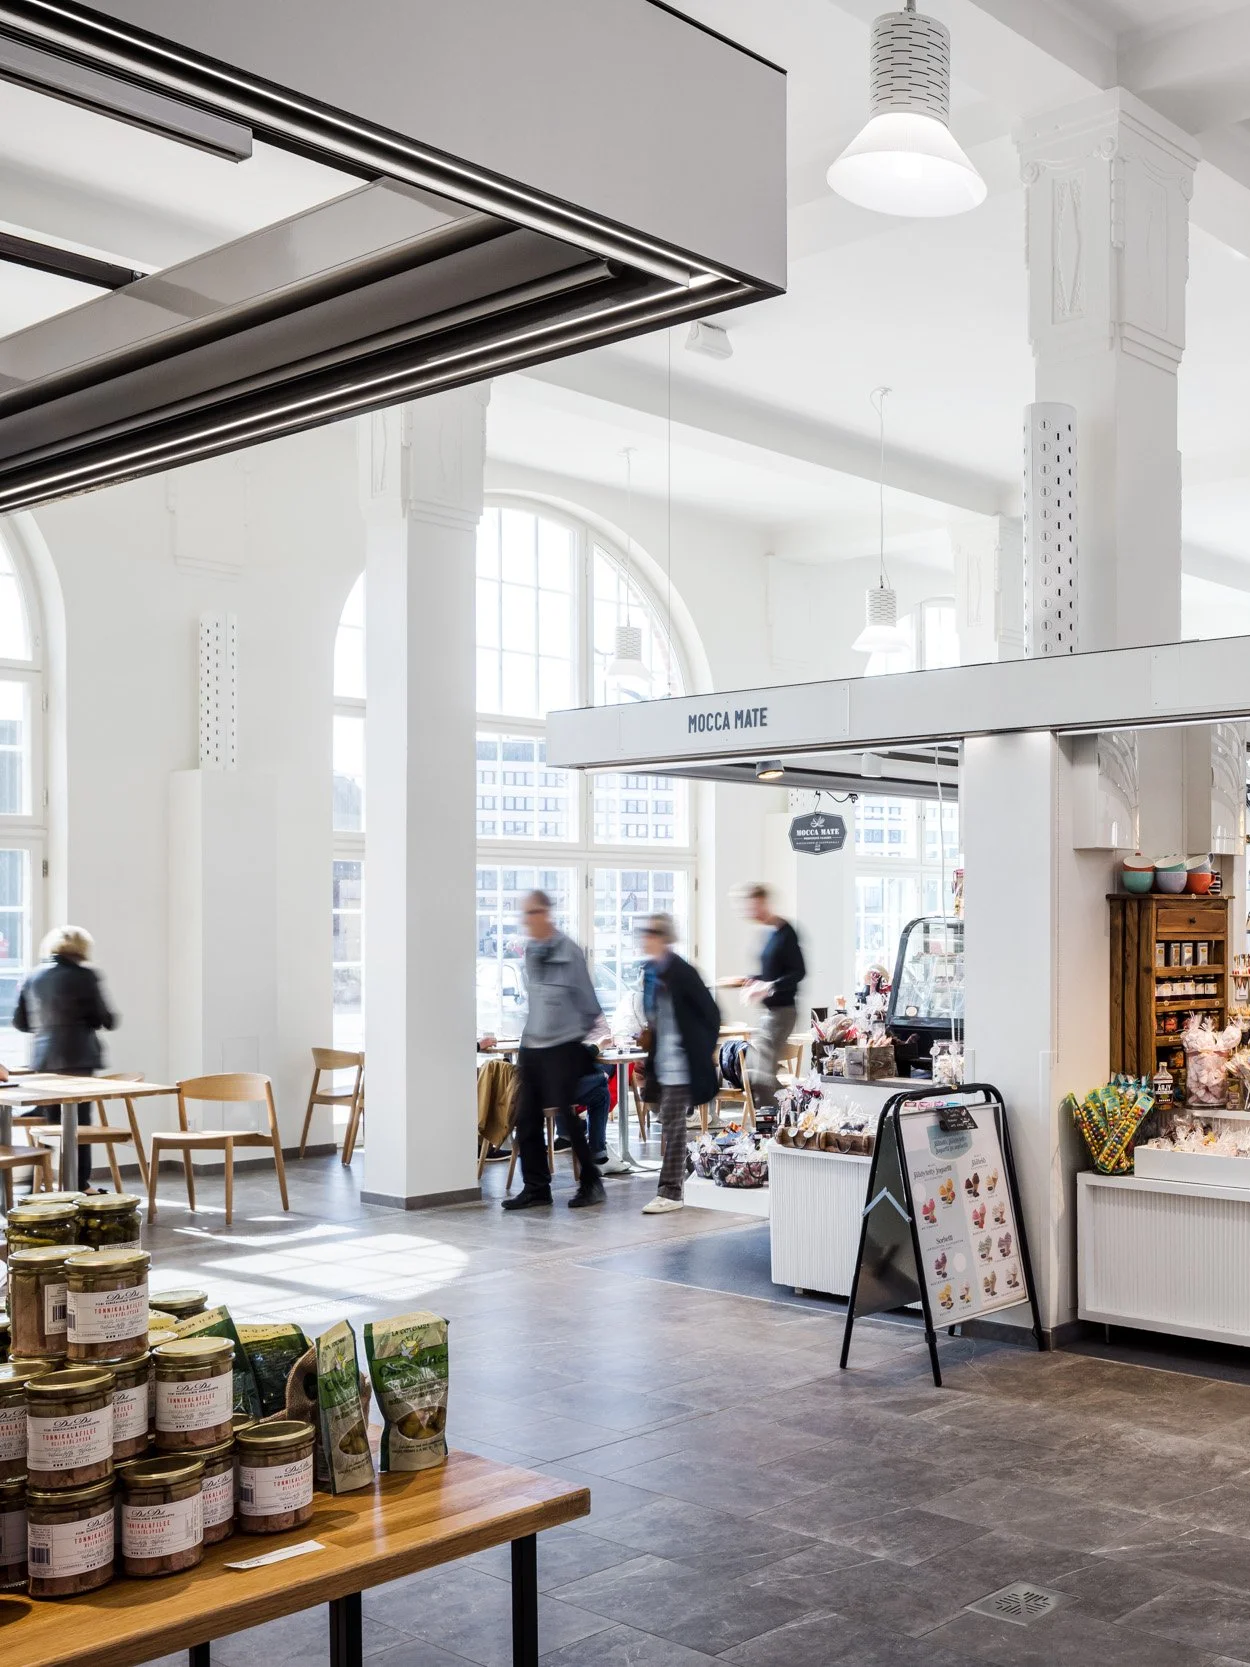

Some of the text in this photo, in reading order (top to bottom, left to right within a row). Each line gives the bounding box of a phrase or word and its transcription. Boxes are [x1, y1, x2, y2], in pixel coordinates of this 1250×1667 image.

[688, 707, 768, 734] MOCCA MATE
[42, 1427, 97, 1440] TONNIKALAFILEE
